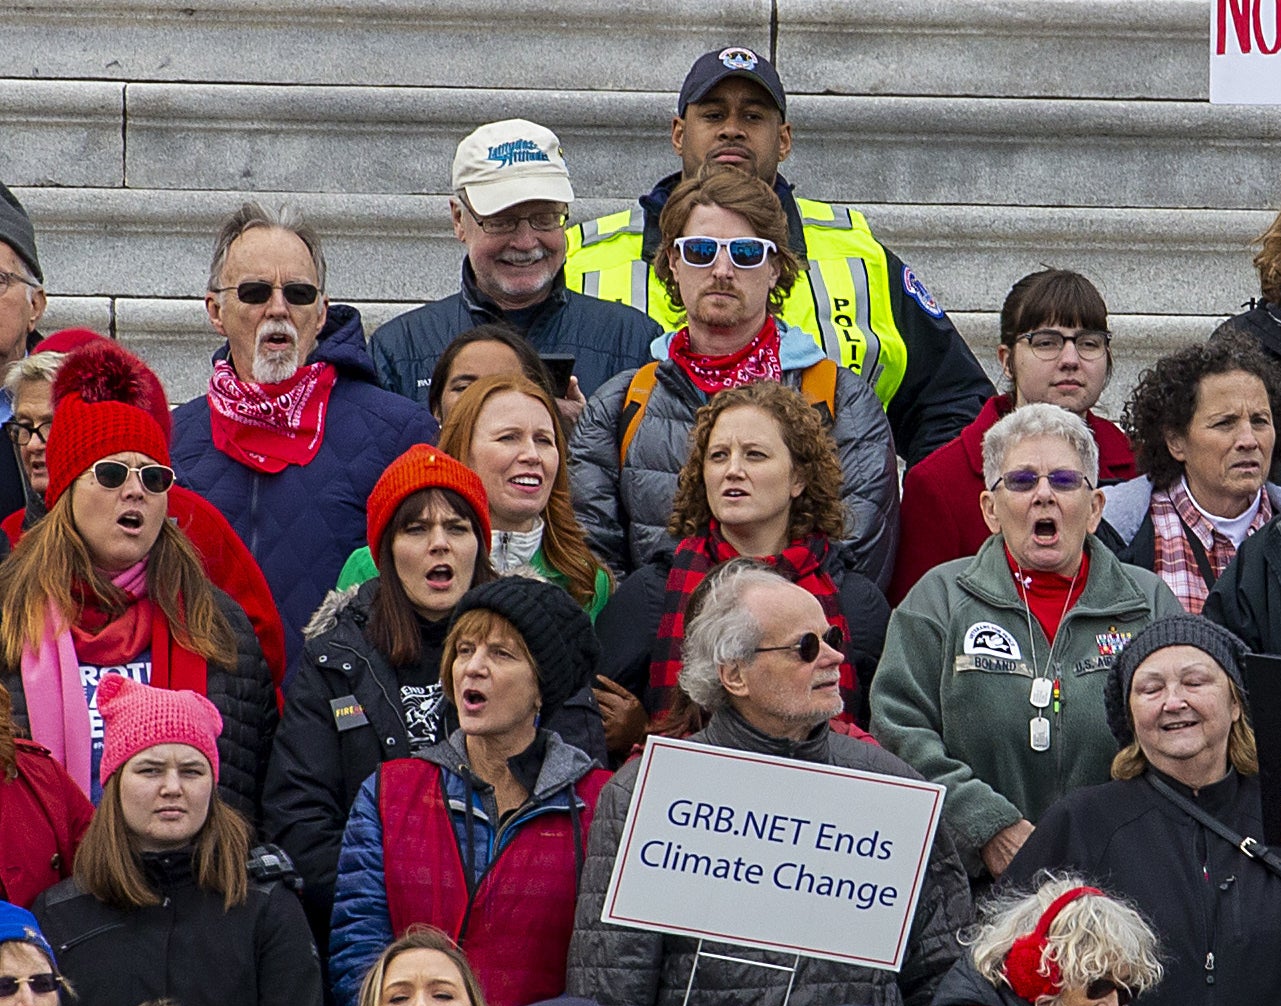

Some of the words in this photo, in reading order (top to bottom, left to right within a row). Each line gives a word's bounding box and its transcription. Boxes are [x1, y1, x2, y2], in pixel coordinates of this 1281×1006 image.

[974, 656, 1017, 672] BOLAND
[667, 799, 811, 846] GRB.NET
[815, 822, 894, 861] Ends
[640, 839, 764, 885] Climate
[772, 861, 898, 911] Change
